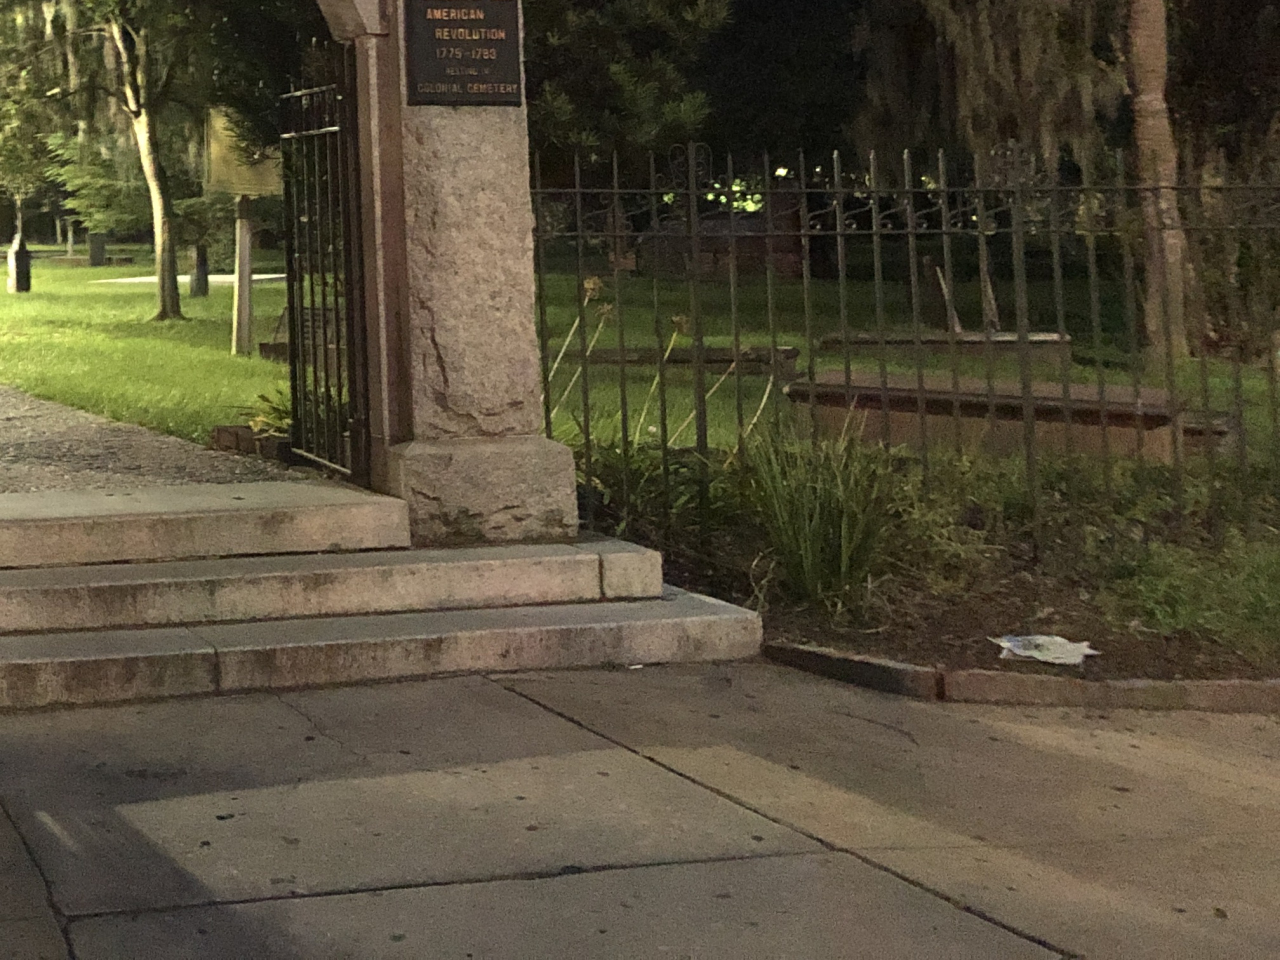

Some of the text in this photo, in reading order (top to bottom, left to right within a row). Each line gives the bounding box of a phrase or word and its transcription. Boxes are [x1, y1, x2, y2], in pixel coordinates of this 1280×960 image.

[426, 8, 485, 20] AMERICAN
[434, 28, 506, 40] REVOLUTION
[417, 83, 518, 94] COLONIAL CEMETERY
